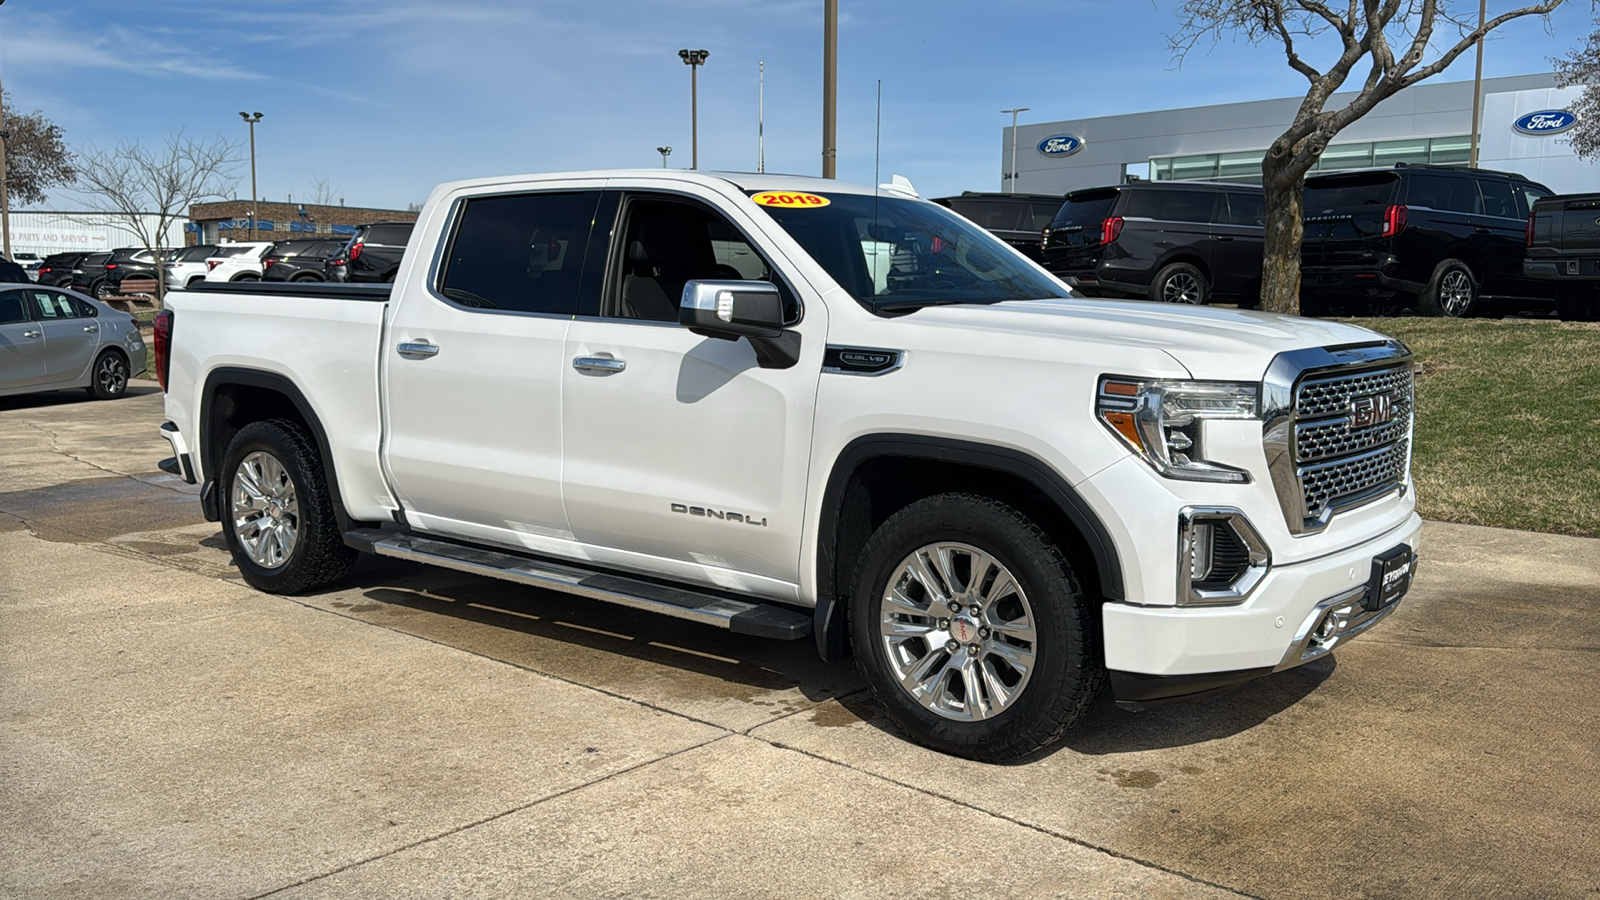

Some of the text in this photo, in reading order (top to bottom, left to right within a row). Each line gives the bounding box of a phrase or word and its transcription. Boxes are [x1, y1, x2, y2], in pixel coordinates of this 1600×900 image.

[1527, 114, 1565, 129] Ford
[1045, 138, 1072, 152] Ford
[762, 194, 823, 205] 2019
[19, 232, 40, 241] PARTS
[42, 233, 58, 242] AND
[61, 234, 89, 243] SERVICE
[1351, 393, 1399, 428] GMC
[671, 503, 767, 527] DENALI
[959, 617, 968, 640] GMC
